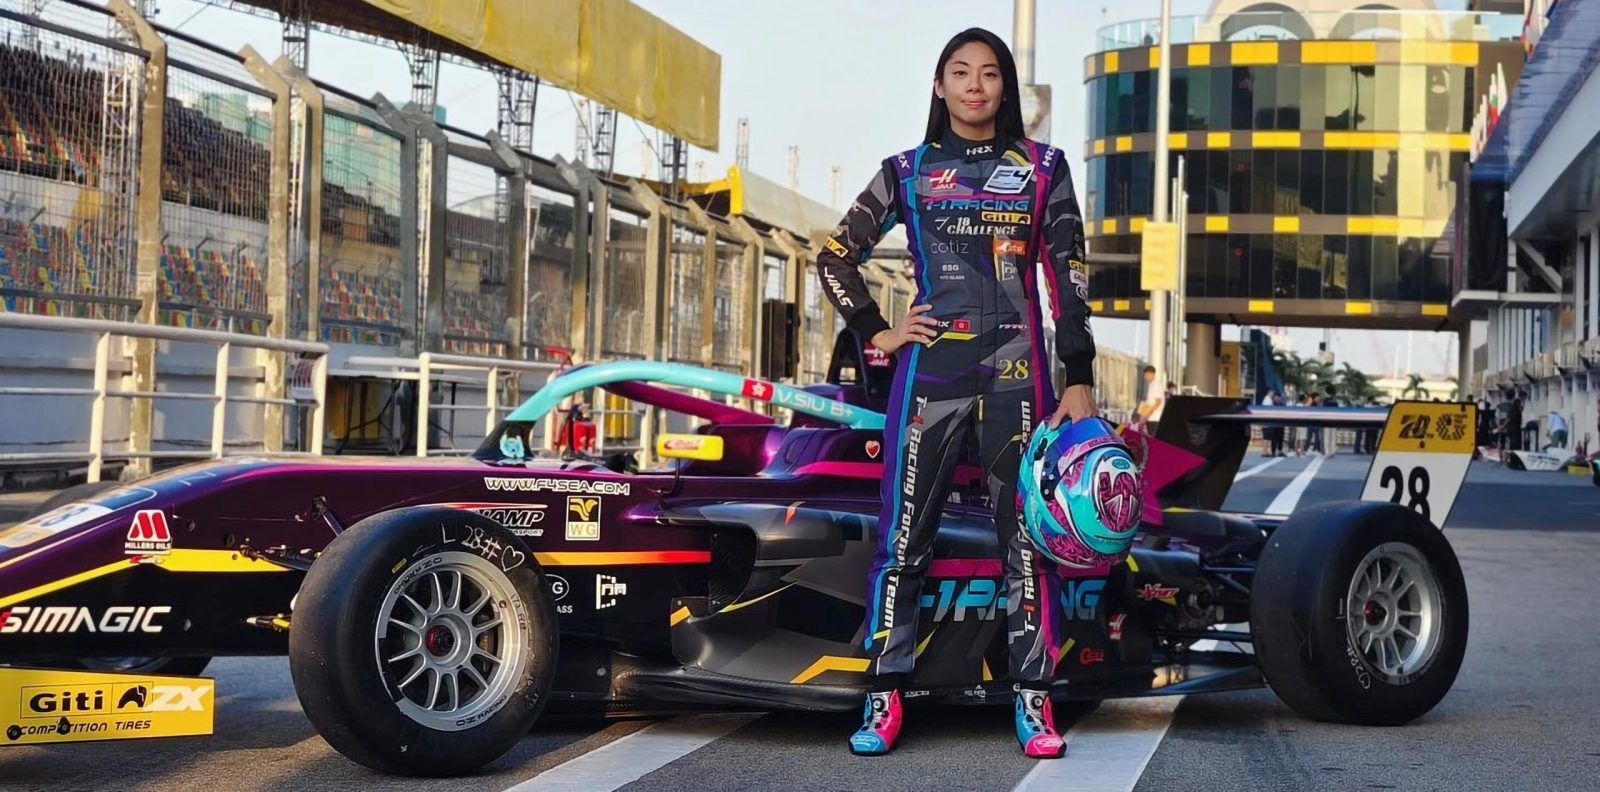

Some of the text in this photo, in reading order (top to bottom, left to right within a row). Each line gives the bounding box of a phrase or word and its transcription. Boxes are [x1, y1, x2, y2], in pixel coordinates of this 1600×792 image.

[946, 225, 1018, 236] CHALLENGE
[931, 240, 969, 254] cotiz
[998, 359, 1029, 380] 28
[777, 388, 826, 412] V.SIU
[904, 427, 922, 497] Racing
[484, 477, 630, 495] WWW.F4SEA.COM
[1380, 466, 1430, 521] 28
[896, 501, 915, 569] Formul
[884, 574, 899, 628] Team
[1, 606, 171, 633] SIMAGIC
[29, 685, 212, 713] Giti ZX
[20, 720, 151, 734] COMPTITION TIRES
